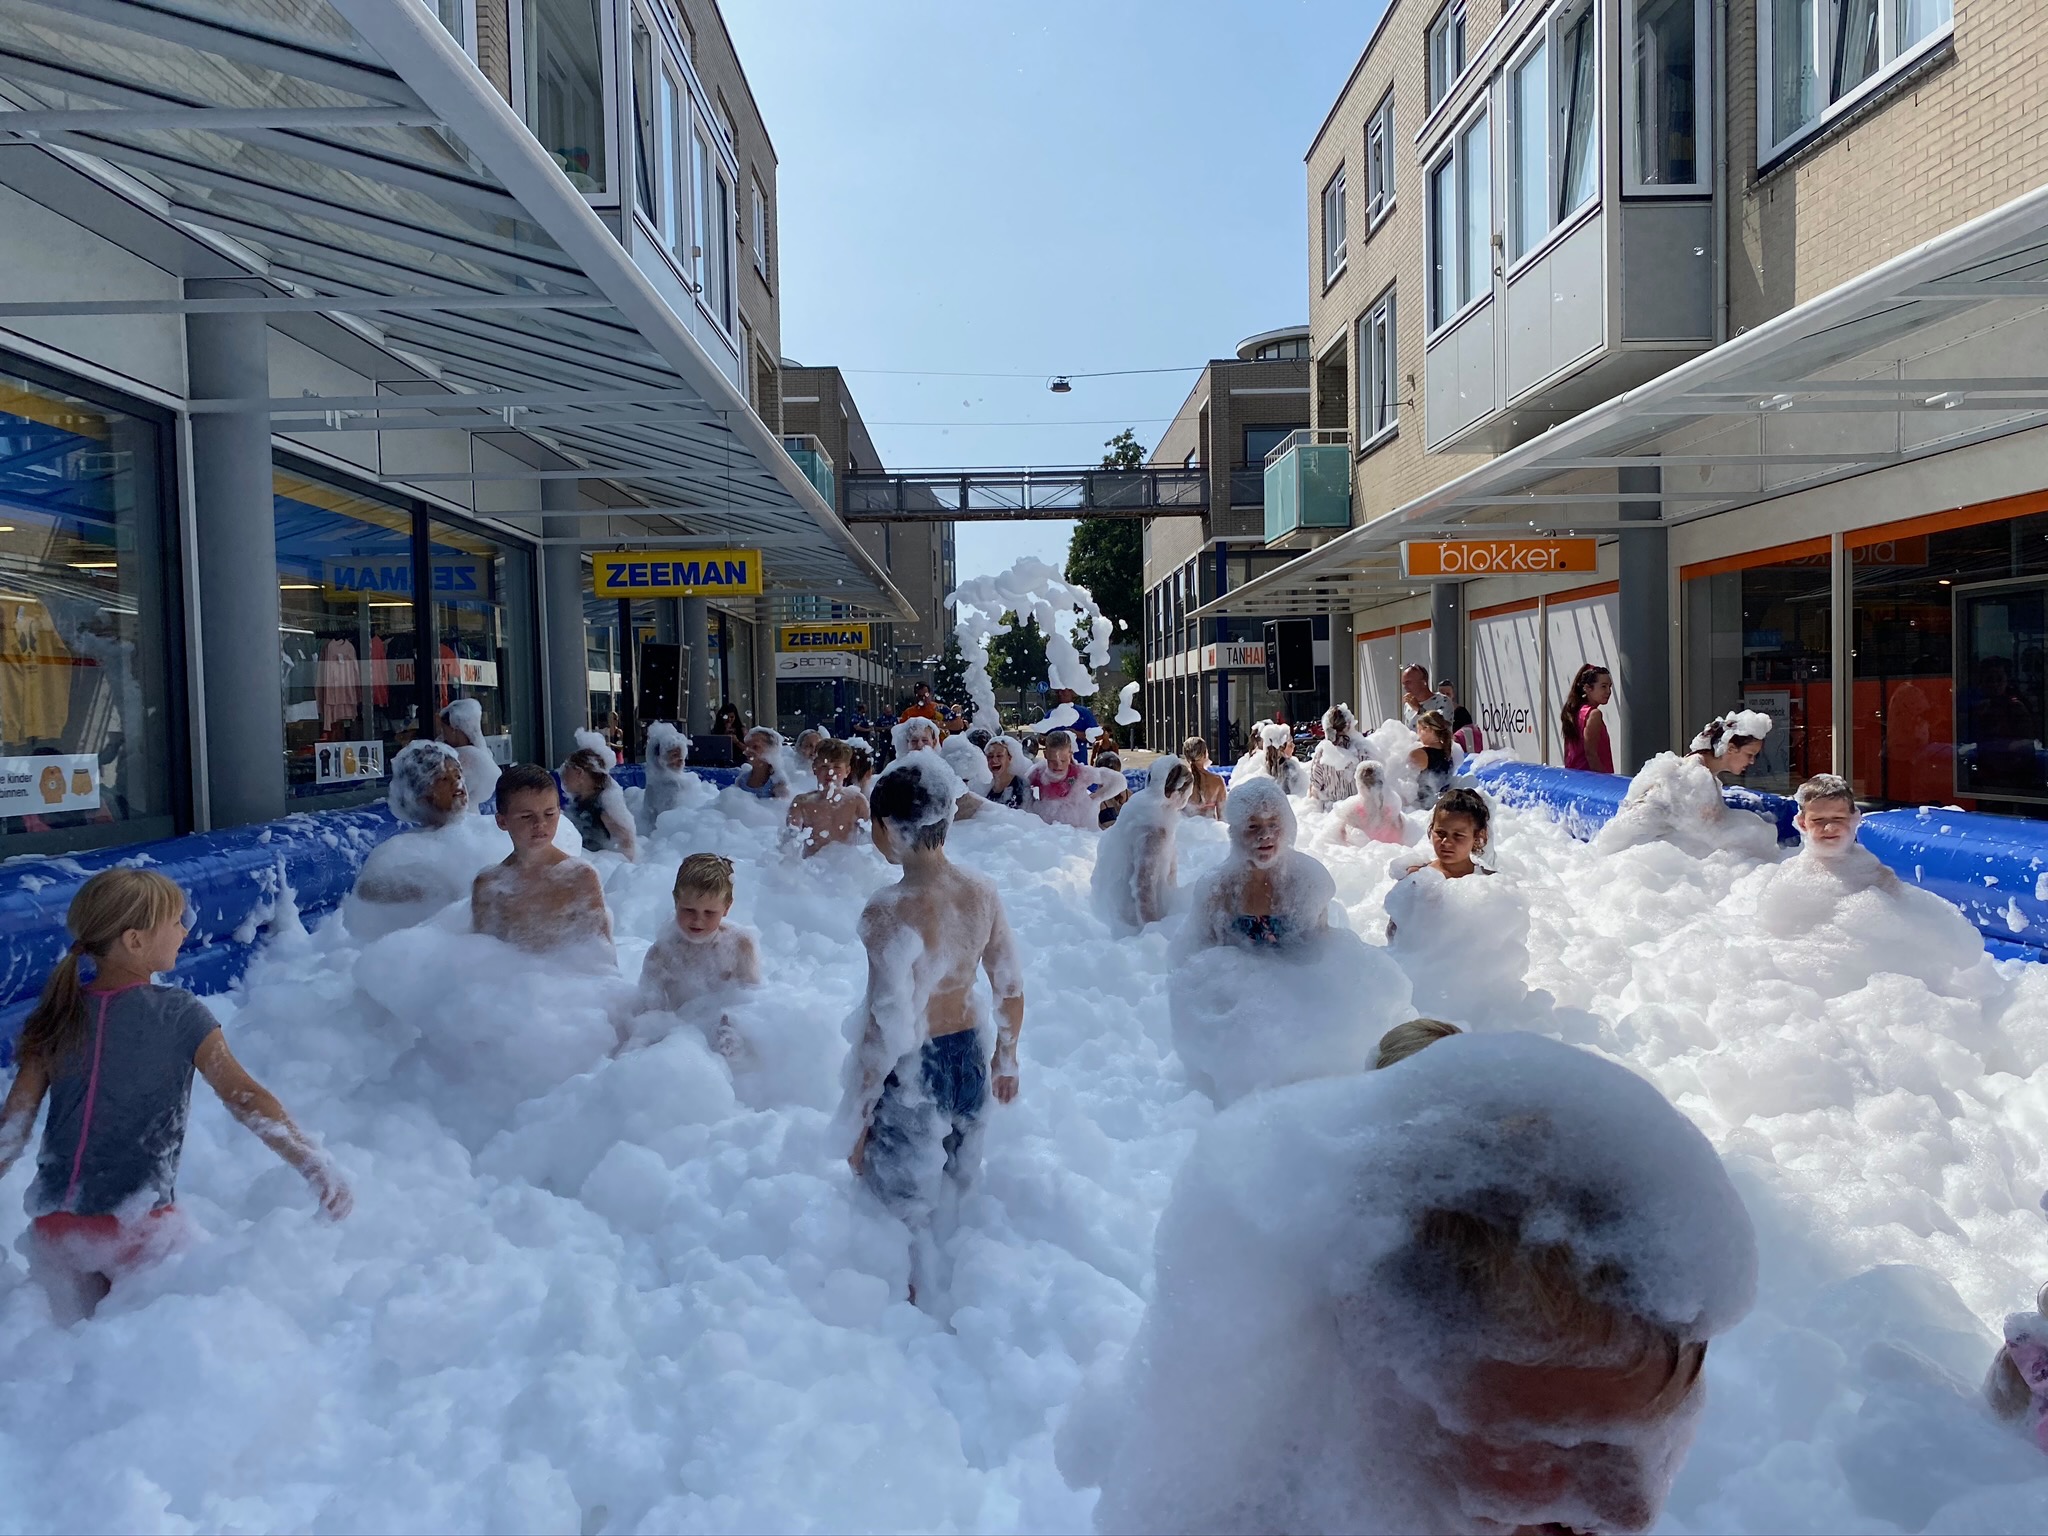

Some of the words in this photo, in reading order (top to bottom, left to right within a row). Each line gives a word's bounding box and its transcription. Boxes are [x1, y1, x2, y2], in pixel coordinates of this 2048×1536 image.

[606, 560, 747, 588] ZEEMAN
[788, 631, 863, 646] ZEEMAN
[1226, 646, 1264, 665] TANHAI
[7, 773, 33, 784] kinder
